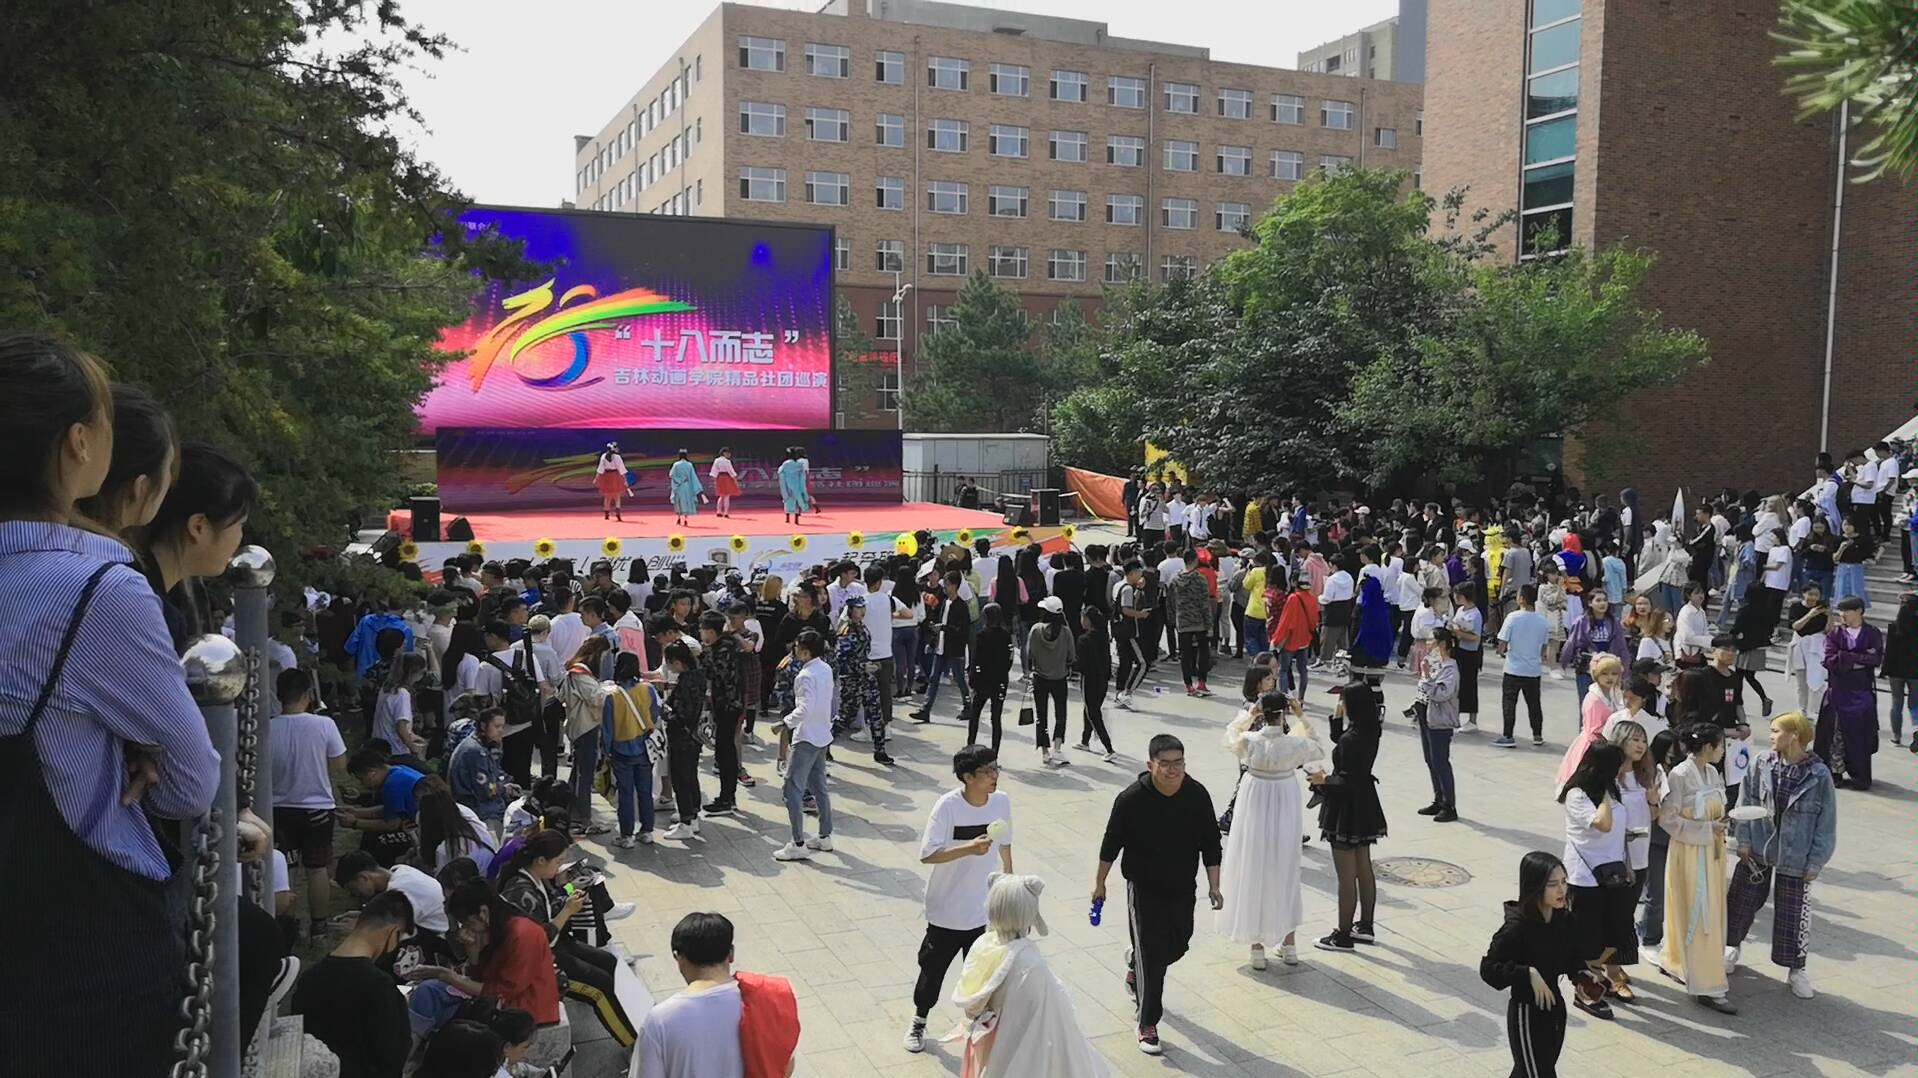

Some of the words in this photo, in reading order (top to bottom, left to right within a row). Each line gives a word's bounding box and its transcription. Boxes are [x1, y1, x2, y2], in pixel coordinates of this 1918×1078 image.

[614, 368, 828, 388] 吉林动画学院精品社团巡演
